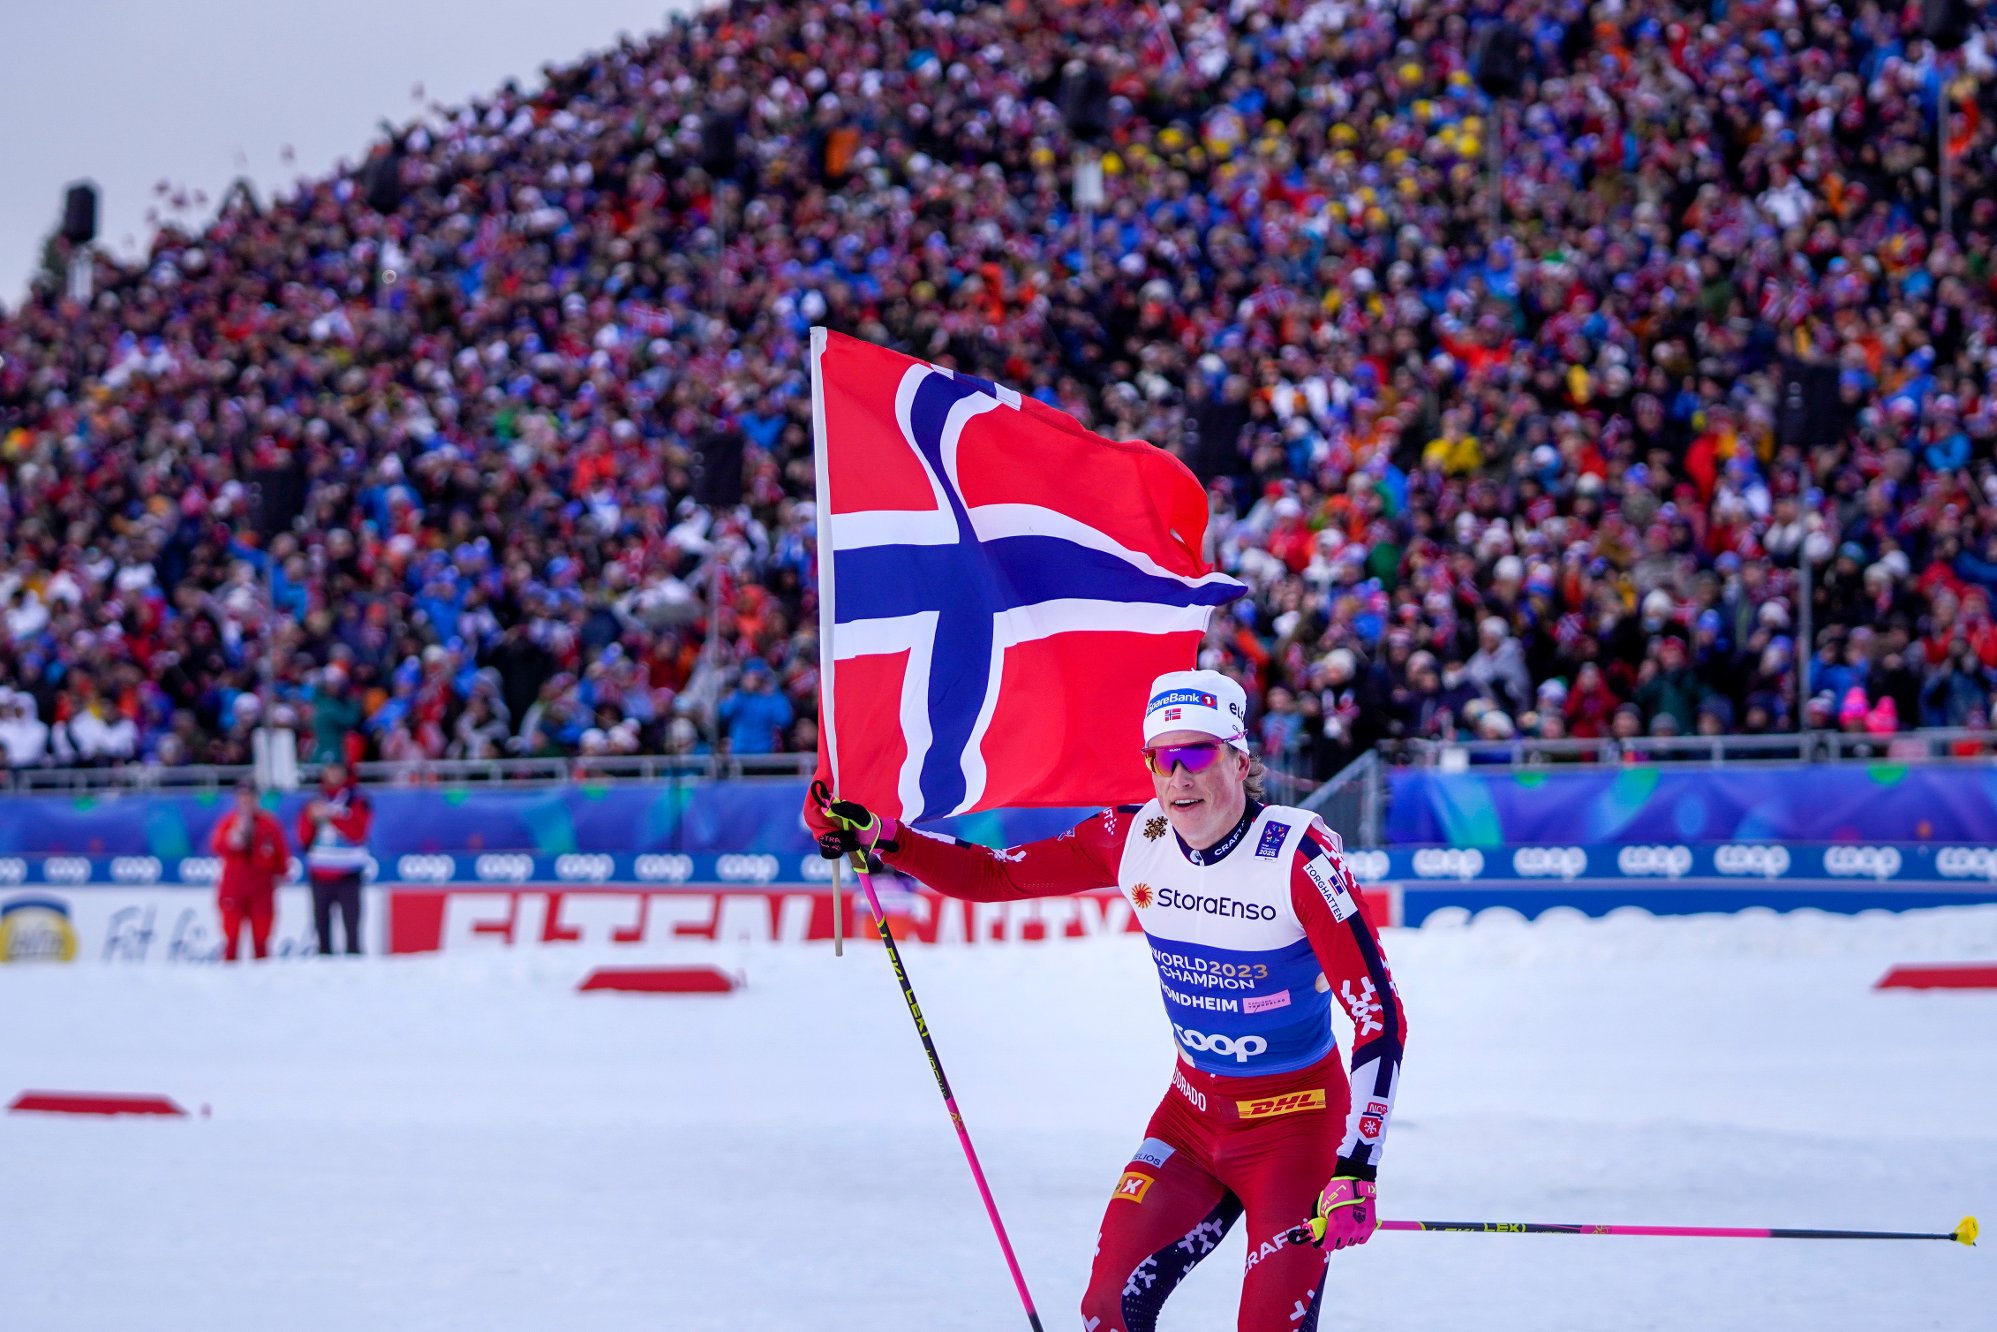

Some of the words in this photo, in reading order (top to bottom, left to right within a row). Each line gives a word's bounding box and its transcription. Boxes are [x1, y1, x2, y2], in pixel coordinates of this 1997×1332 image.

[1157, 888, 1277, 921] StoraEnso
[1305, 863, 1345, 921] TORGHATTEN
[1151, 948, 1208, 972] WORLD
[1209, 961, 1269, 979] 2023
[1160, 965, 1255, 990] CHAMPION
[905, 988, 929, 1037] LEKI
[1160, 979, 1239, 1013] RONDHEIM
[1173, 1023, 1268, 1063] coop
[1250, 1094, 1316, 1115] DHL
[1483, 1223, 1527, 1232] LEKI
